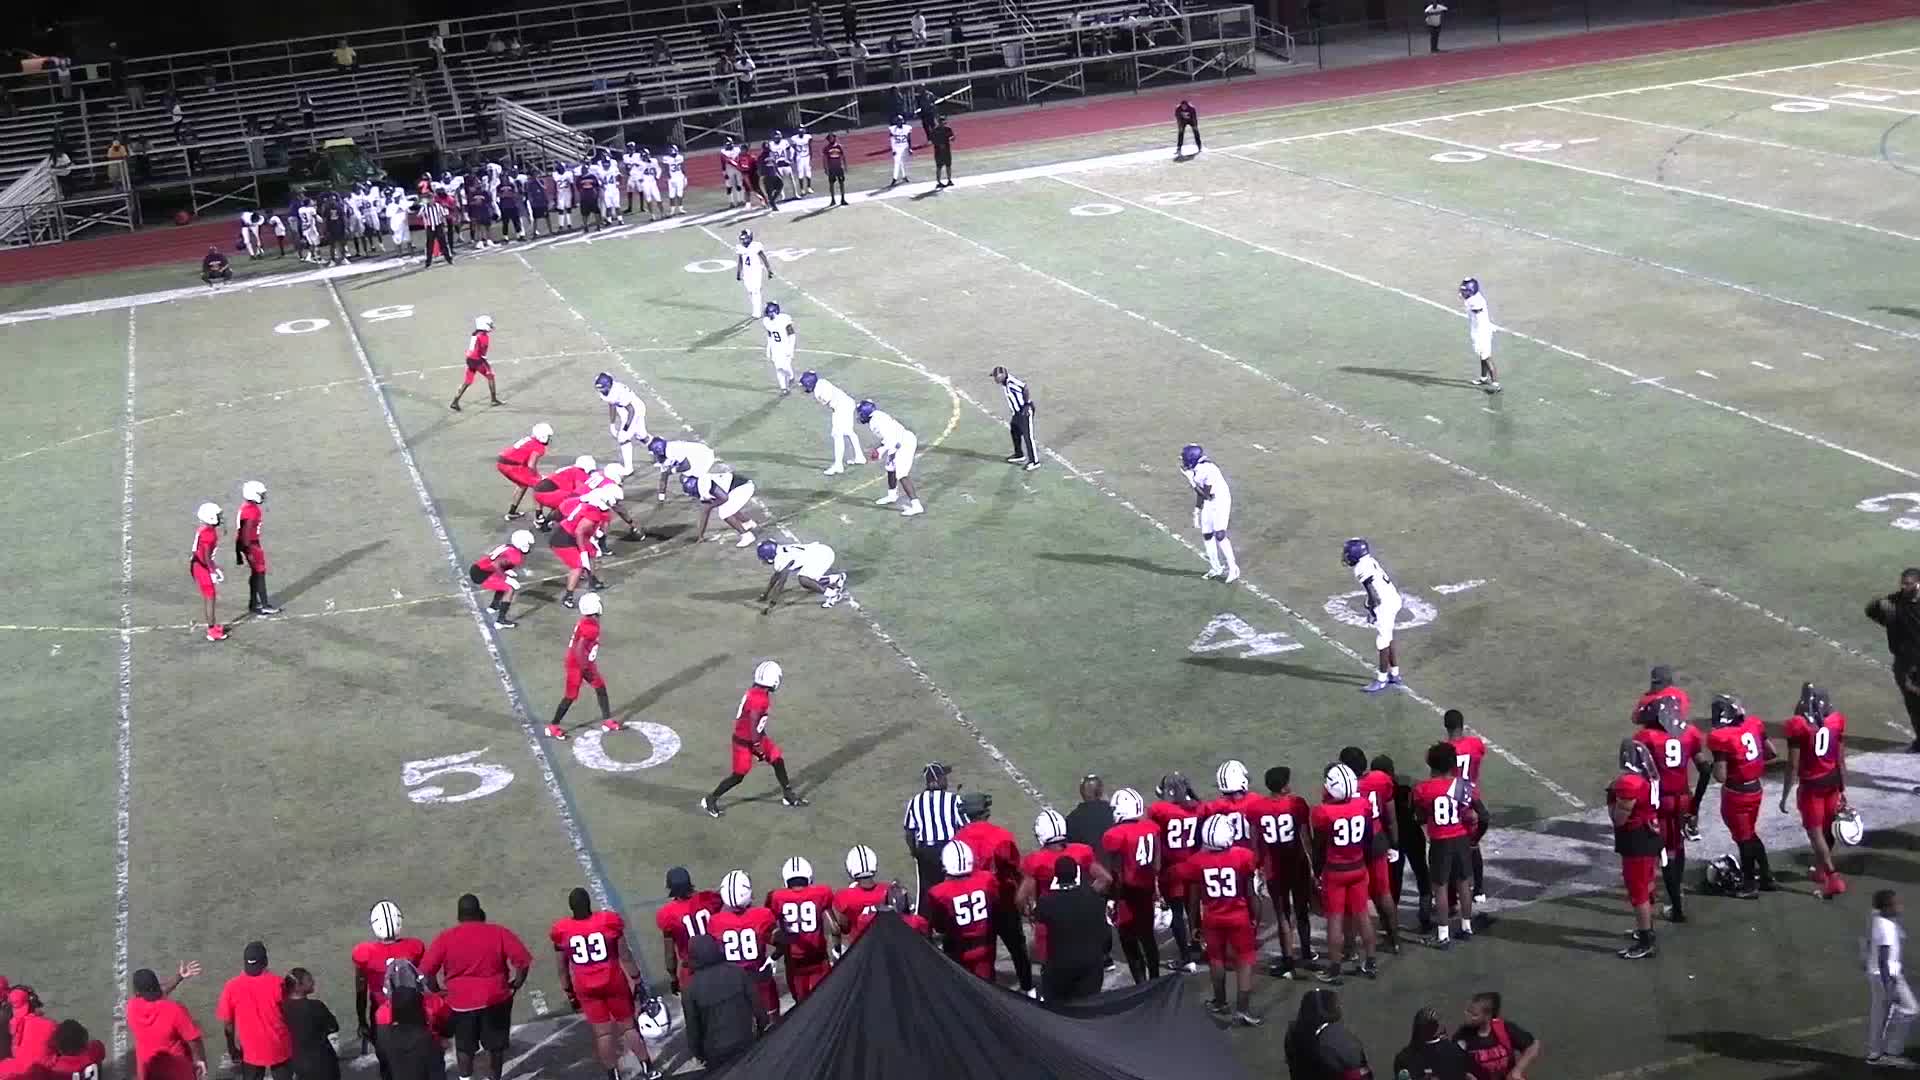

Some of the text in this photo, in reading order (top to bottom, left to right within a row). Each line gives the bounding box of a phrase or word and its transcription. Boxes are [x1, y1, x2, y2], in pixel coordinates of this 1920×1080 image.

[745, 256, 751, 266] 4
[1665, 738, 1682, 768] 9
[1740, 732, 1759, 761] 3
[1814, 726, 1830, 757] 0
[1433, 796, 1460, 826] 81
[1167, 816, 1198, 849] 27
[1260, 813, 1295, 844] 32
[1333, 815, 1366, 847] 38
[1135, 833, 1154, 866] 41
[1203, 867, 1237, 898] 53
[682, 908, 711, 937] 10
[782, 901, 817, 933] 29
[952, 889, 988, 926] 52
[569, 931, 608, 964] 33
[722, 927, 759, 961] 28
